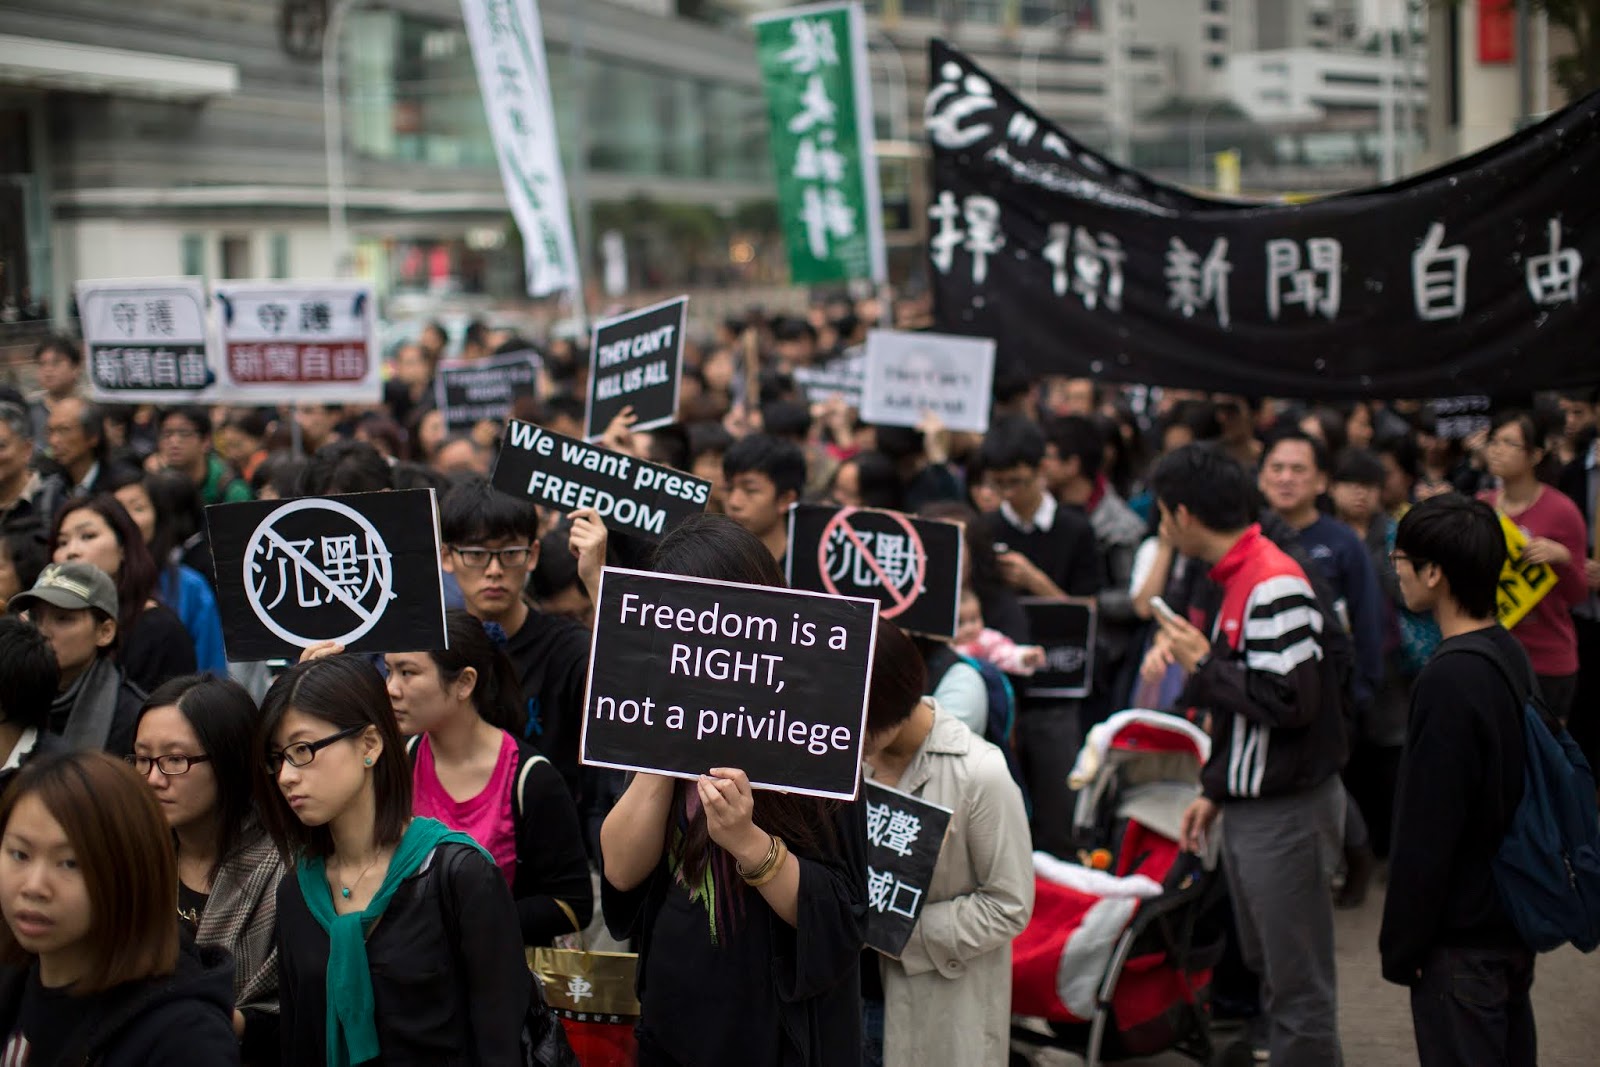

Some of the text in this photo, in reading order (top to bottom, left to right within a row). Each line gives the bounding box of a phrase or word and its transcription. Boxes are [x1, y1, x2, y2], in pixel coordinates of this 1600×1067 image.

[96, 347, 204, 388] 新聞自由
[231, 345, 364, 380] 新聞自由
[598, 325, 676, 369] THEY CAN'T
[596, 360, 669, 401] KILL US ALL
[510, 420, 709, 505] We want press
[526, 470, 666, 535] FREEDOM
[250, 532, 398, 610] 沉默
[826, 526, 928, 594] 沉默
[620, 593, 848, 650] Freedom is a
[670, 643, 785, 693] RIGHT,
[596, 696, 851, 756] not a privilege
